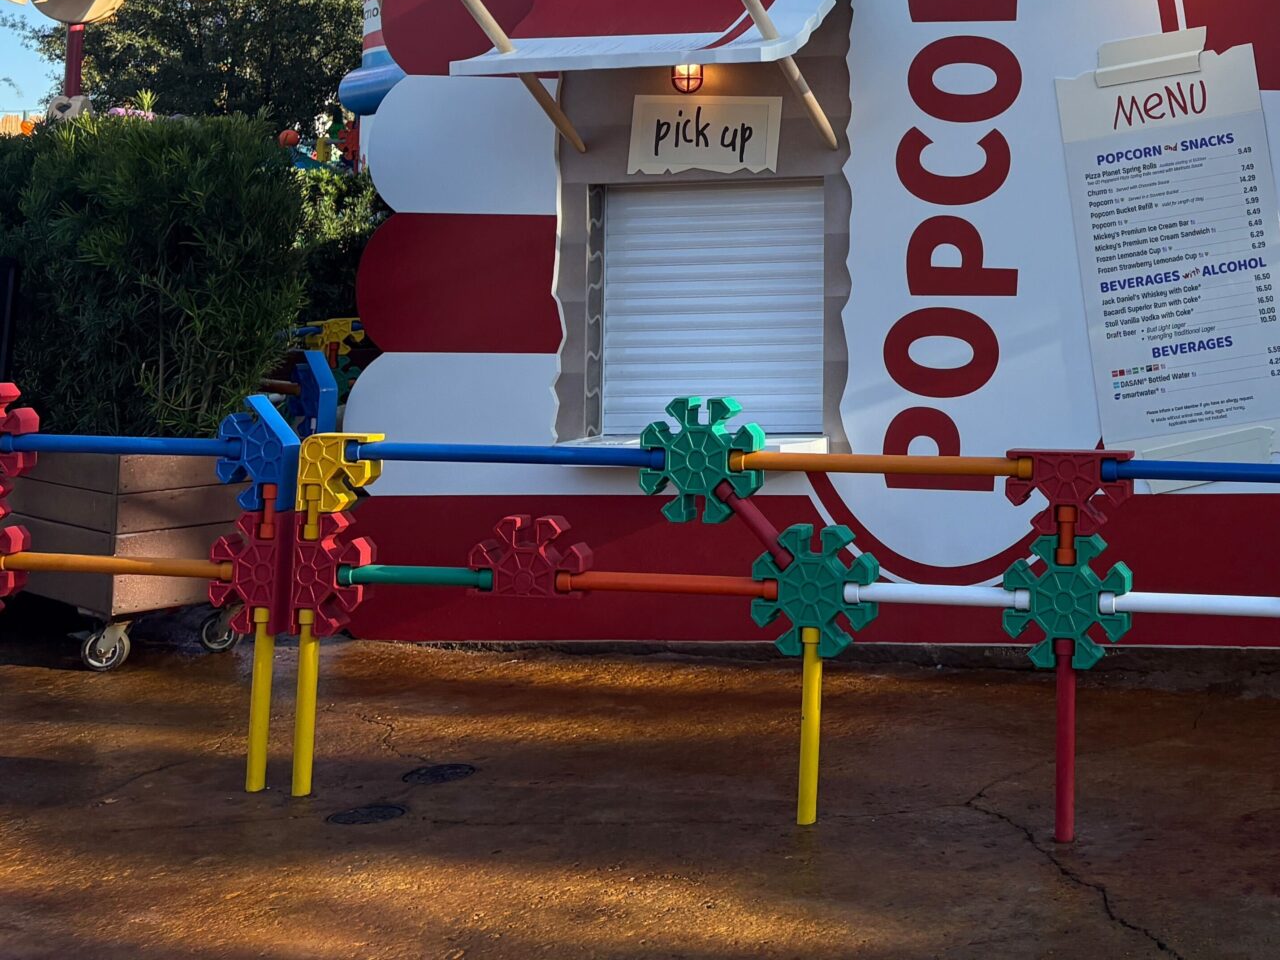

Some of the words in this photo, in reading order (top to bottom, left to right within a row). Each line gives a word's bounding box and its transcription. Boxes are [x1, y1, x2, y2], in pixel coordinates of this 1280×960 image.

[654, 106, 710, 156] pick
[720, 123, 753, 162] up
[1097, 145, 1162, 166] POPCORN
[1164, 143, 1178, 153] and
[1181, 133, 1234, 152] SNACKS
[1085, 172, 1100, 181] Pizza
[1102, 169, 1120, 178] Planet
[1122, 165, 1141, 176] Spring
[1143, 162, 1157, 171] Rolls
[1088, 189, 1107, 197] Churro
[1241, 164, 1254, 172] 7.49
[1089, 199, 1113, 209] Popcorn
[1240, 175, 1256, 183] 14.29
[1091, 210, 1115, 220] Popcorn
[1116, 206, 1136, 215] Bucket
[1138, 203, 1153, 211] Refill
[1244, 186, 1257, 194] 2.49
[1092, 221, 1116, 231] Popcorn
[1246, 197, 1259, 205] 5.99
[1094, 231, 1119, 243] Mickey's
[1121, 227, 1146, 236] Premium
[1158, 222, 1177, 230] Cream
[1247, 208, 1260, 216] 6.49
[1095, 242, 1121, 254] Mickey's
[1123, 238, 1148, 247] Premium
[1160, 233, 1179, 241] Cream
[1181, 227, 1210, 238] Sandwich
[1249, 219, 1262, 227] 6.49
[1096, 255, 1116, 263] Frozen
[1118, 249, 1147, 260] Lemonade
[1149, 247, 1161, 256] Cup
[1250, 230, 1264, 238] 6.29
[1098, 265, 1117, 274] Frozen
[1119, 260, 1152, 273] Strawberry
[1154, 254, 1183, 265] Lemonade
[1185, 253, 1197, 261] Cup
[1252, 242, 1265, 250] 6.29
[1100, 270, 1180, 294] BEVERAGES
[1183, 267, 1200, 279] with
[1202, 256, 1267, 277] ALCOHOL
[1102, 298, 1115, 306] Jack
[1117, 294, 1140, 303] Daniel's
[1142, 289, 1167, 301] Whiskey
[1169, 287, 1182, 295] with
[1255, 273, 1270, 281] 16.50
[1120, 317, 1140, 326] Vanilla
[1141, 314, 1160, 322] Vodka
[1161, 311, 1174, 319] with
[1257, 296, 1274, 304] 16.50
[1128, 304, 1152, 314] Superior
[1168, 299, 1182, 307] with
[1256, 284, 1272, 293] 16.50
[1107, 331, 1121, 340] Draft
[1123, 329, 1136, 337] Beer
[1259, 307, 1275, 315] 10.00
[1260, 315, 1276, 323] 10.50
[1152, 335, 1232, 359] BEVERAGES
[1148, 374, 1170, 384] Bottled
[1172, 372, 1189, 380] Water
